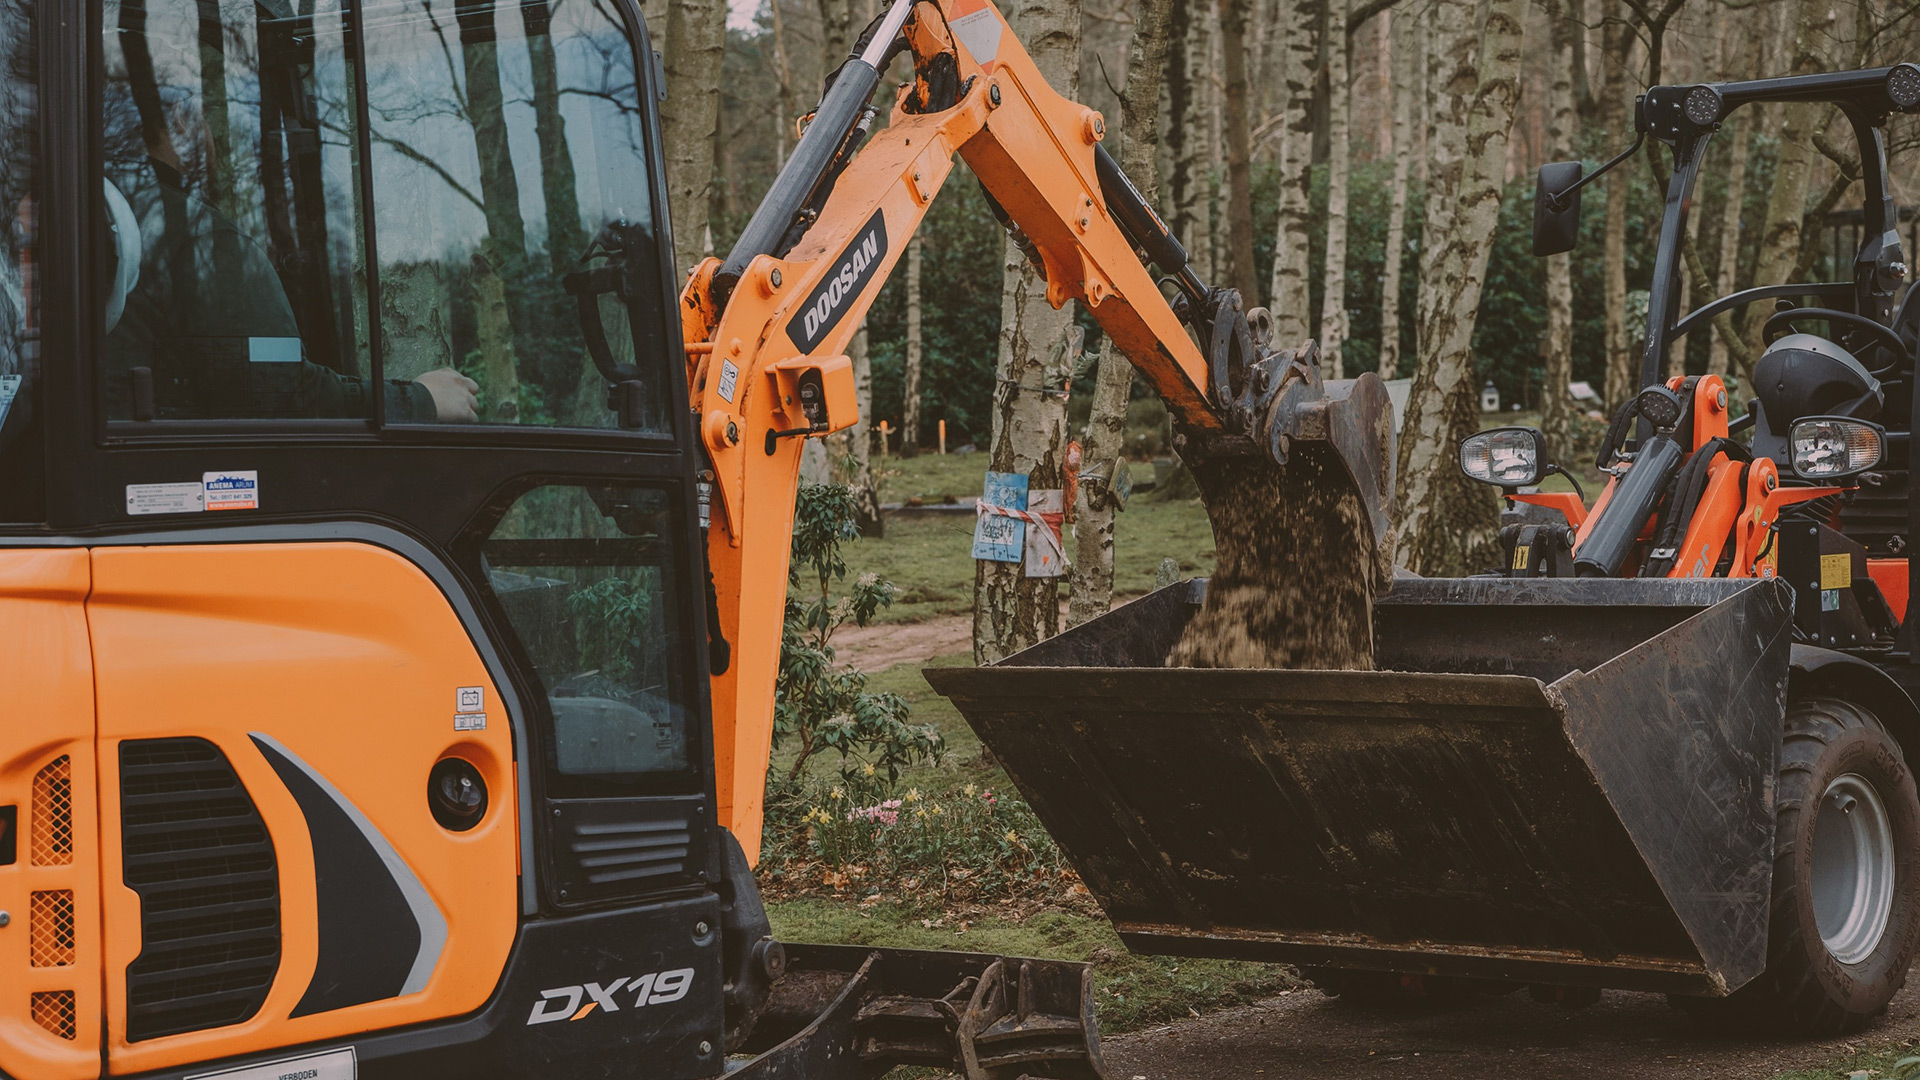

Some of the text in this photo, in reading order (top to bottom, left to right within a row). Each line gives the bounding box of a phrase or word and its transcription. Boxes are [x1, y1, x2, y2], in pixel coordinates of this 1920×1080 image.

[804, 229, 878, 342] DOOSAN
[208, 482, 234, 490] ANEMA
[526, 968, 695, 1026] DX19
[278, 1069, 318, 1080] VERBODEN
